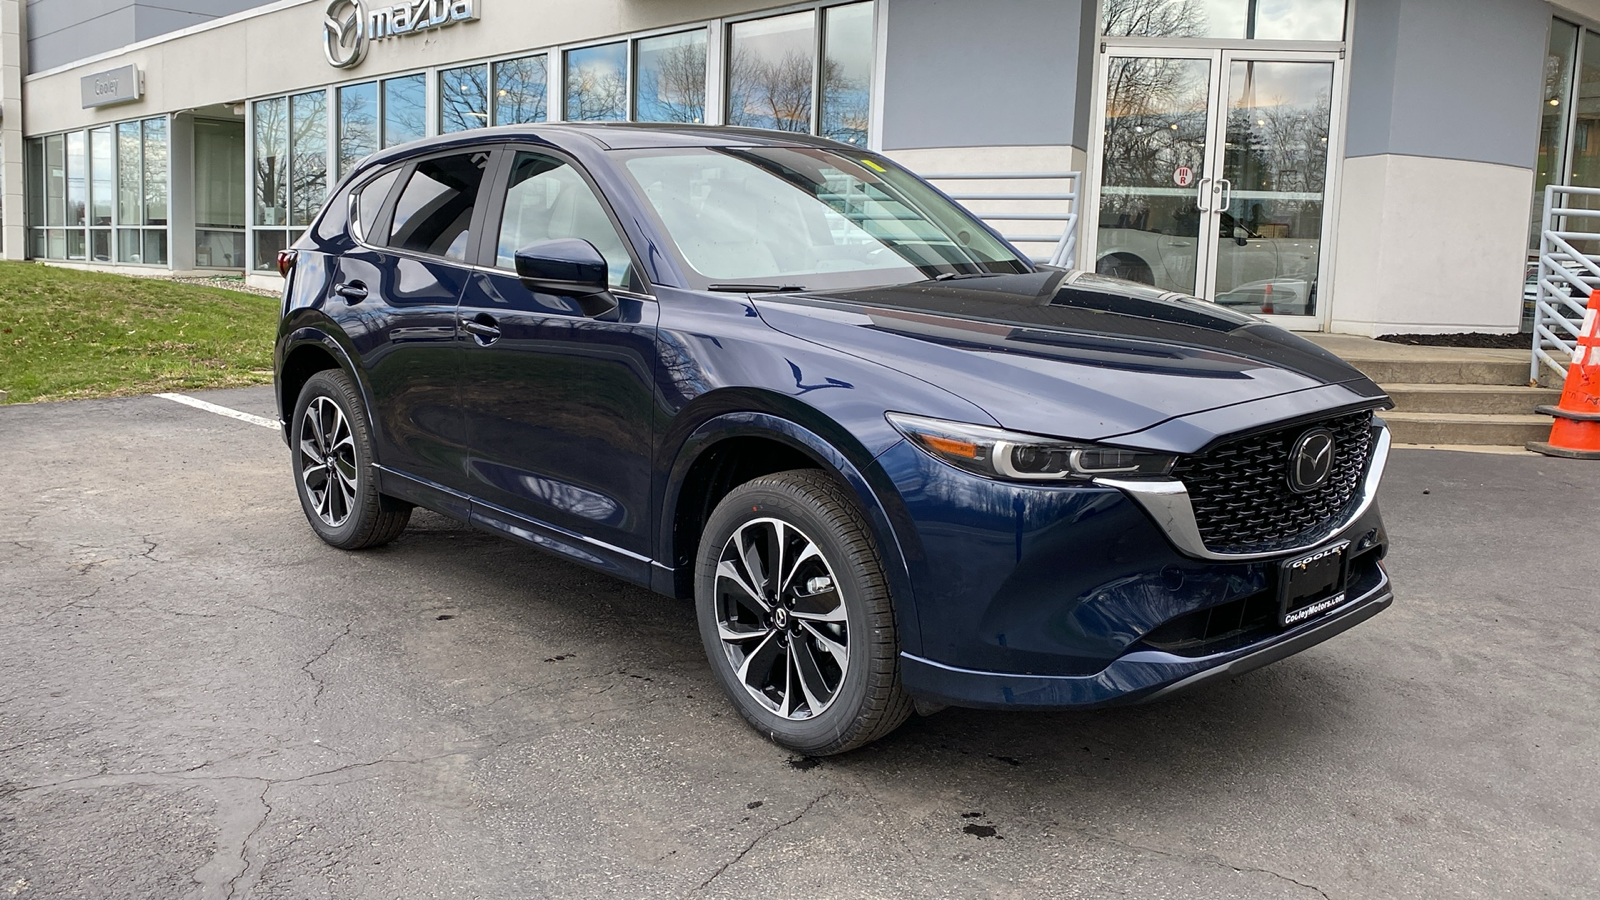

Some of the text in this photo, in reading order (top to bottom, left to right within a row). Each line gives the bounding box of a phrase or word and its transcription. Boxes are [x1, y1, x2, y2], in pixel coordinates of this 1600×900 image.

[95, 78, 119, 97] Cooley
[1180, 176, 1187, 184] R
[1292, 543, 1350, 568] COOLEY
[1285, 594, 1345, 624] CooleyMotors.com
